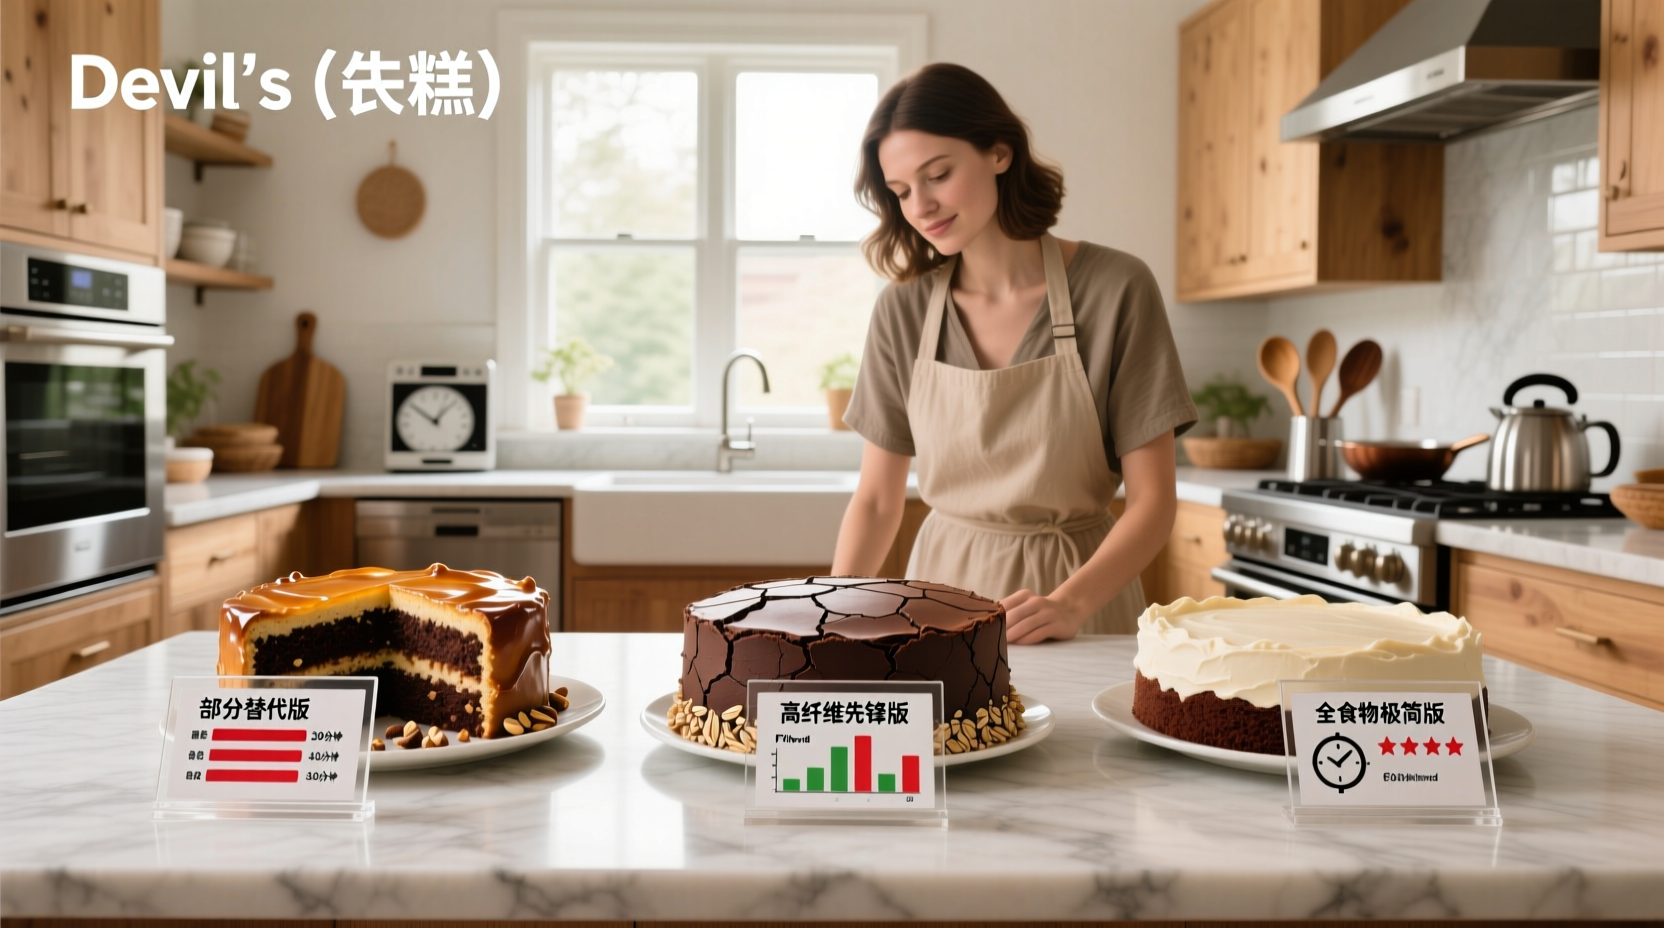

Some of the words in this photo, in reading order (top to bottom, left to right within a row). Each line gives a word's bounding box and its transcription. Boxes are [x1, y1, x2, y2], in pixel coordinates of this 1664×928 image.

[199, 696, 311, 721] 部分替代版
[780, 700, 909, 725] 高纤维先锋版
[1315, 700, 1446, 725] 全食物极简版
